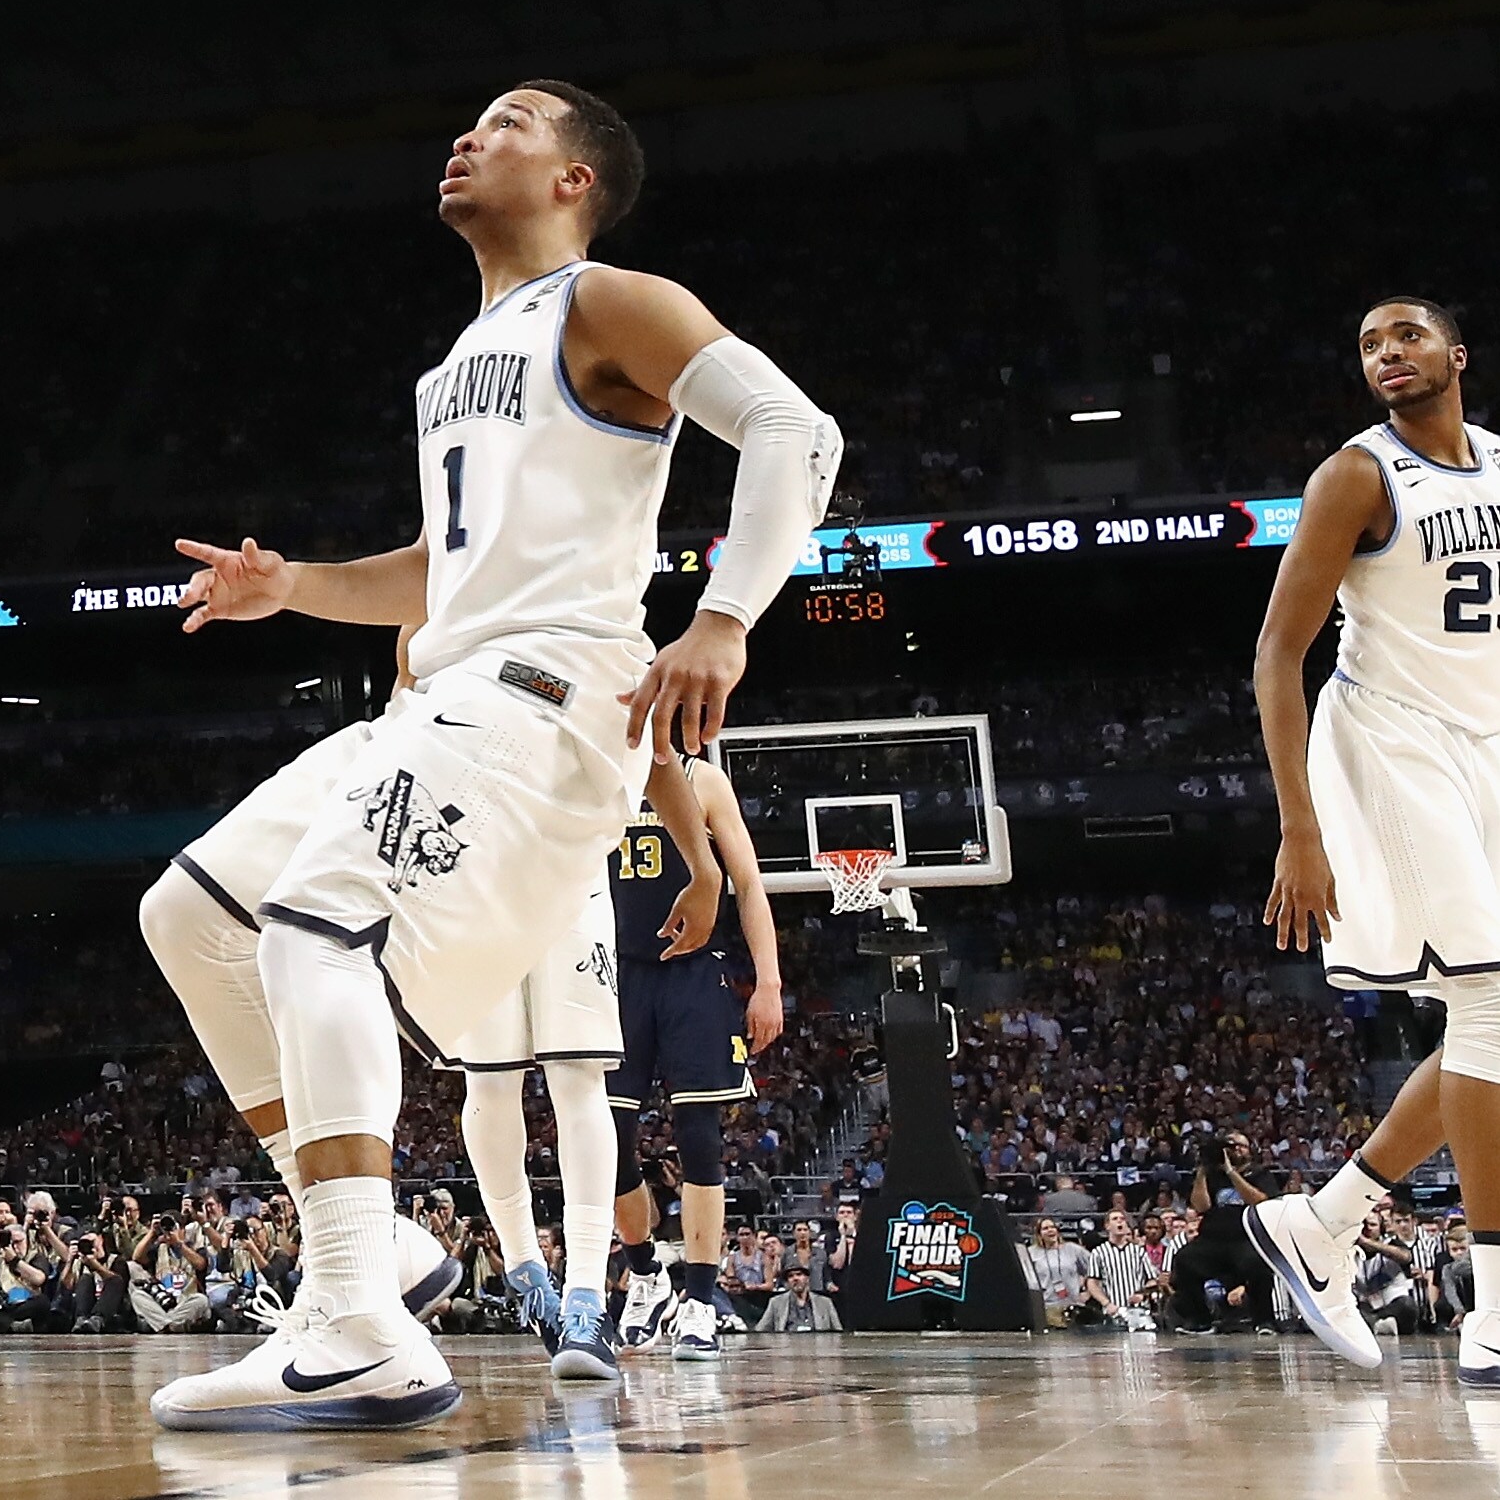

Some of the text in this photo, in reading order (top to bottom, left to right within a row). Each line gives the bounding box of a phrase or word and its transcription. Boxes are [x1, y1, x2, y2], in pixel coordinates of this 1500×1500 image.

[443, 446, 468, 553] 1
[1264, 508, 1300, 522] BON
[963, 514, 1224, 555] 10:58 2ND HALF
[680, 550, 699, 572] 2
[870, 548, 911, 563] OSS
[72, 588, 118, 611] THE
[806, 592, 884, 622] 10:58
[1444, 562, 1500, 633] 2
[618, 835, 662, 879] 13
[892, 1222, 959, 1247] FINAL
[898, 1245, 962, 1267] FOUR
